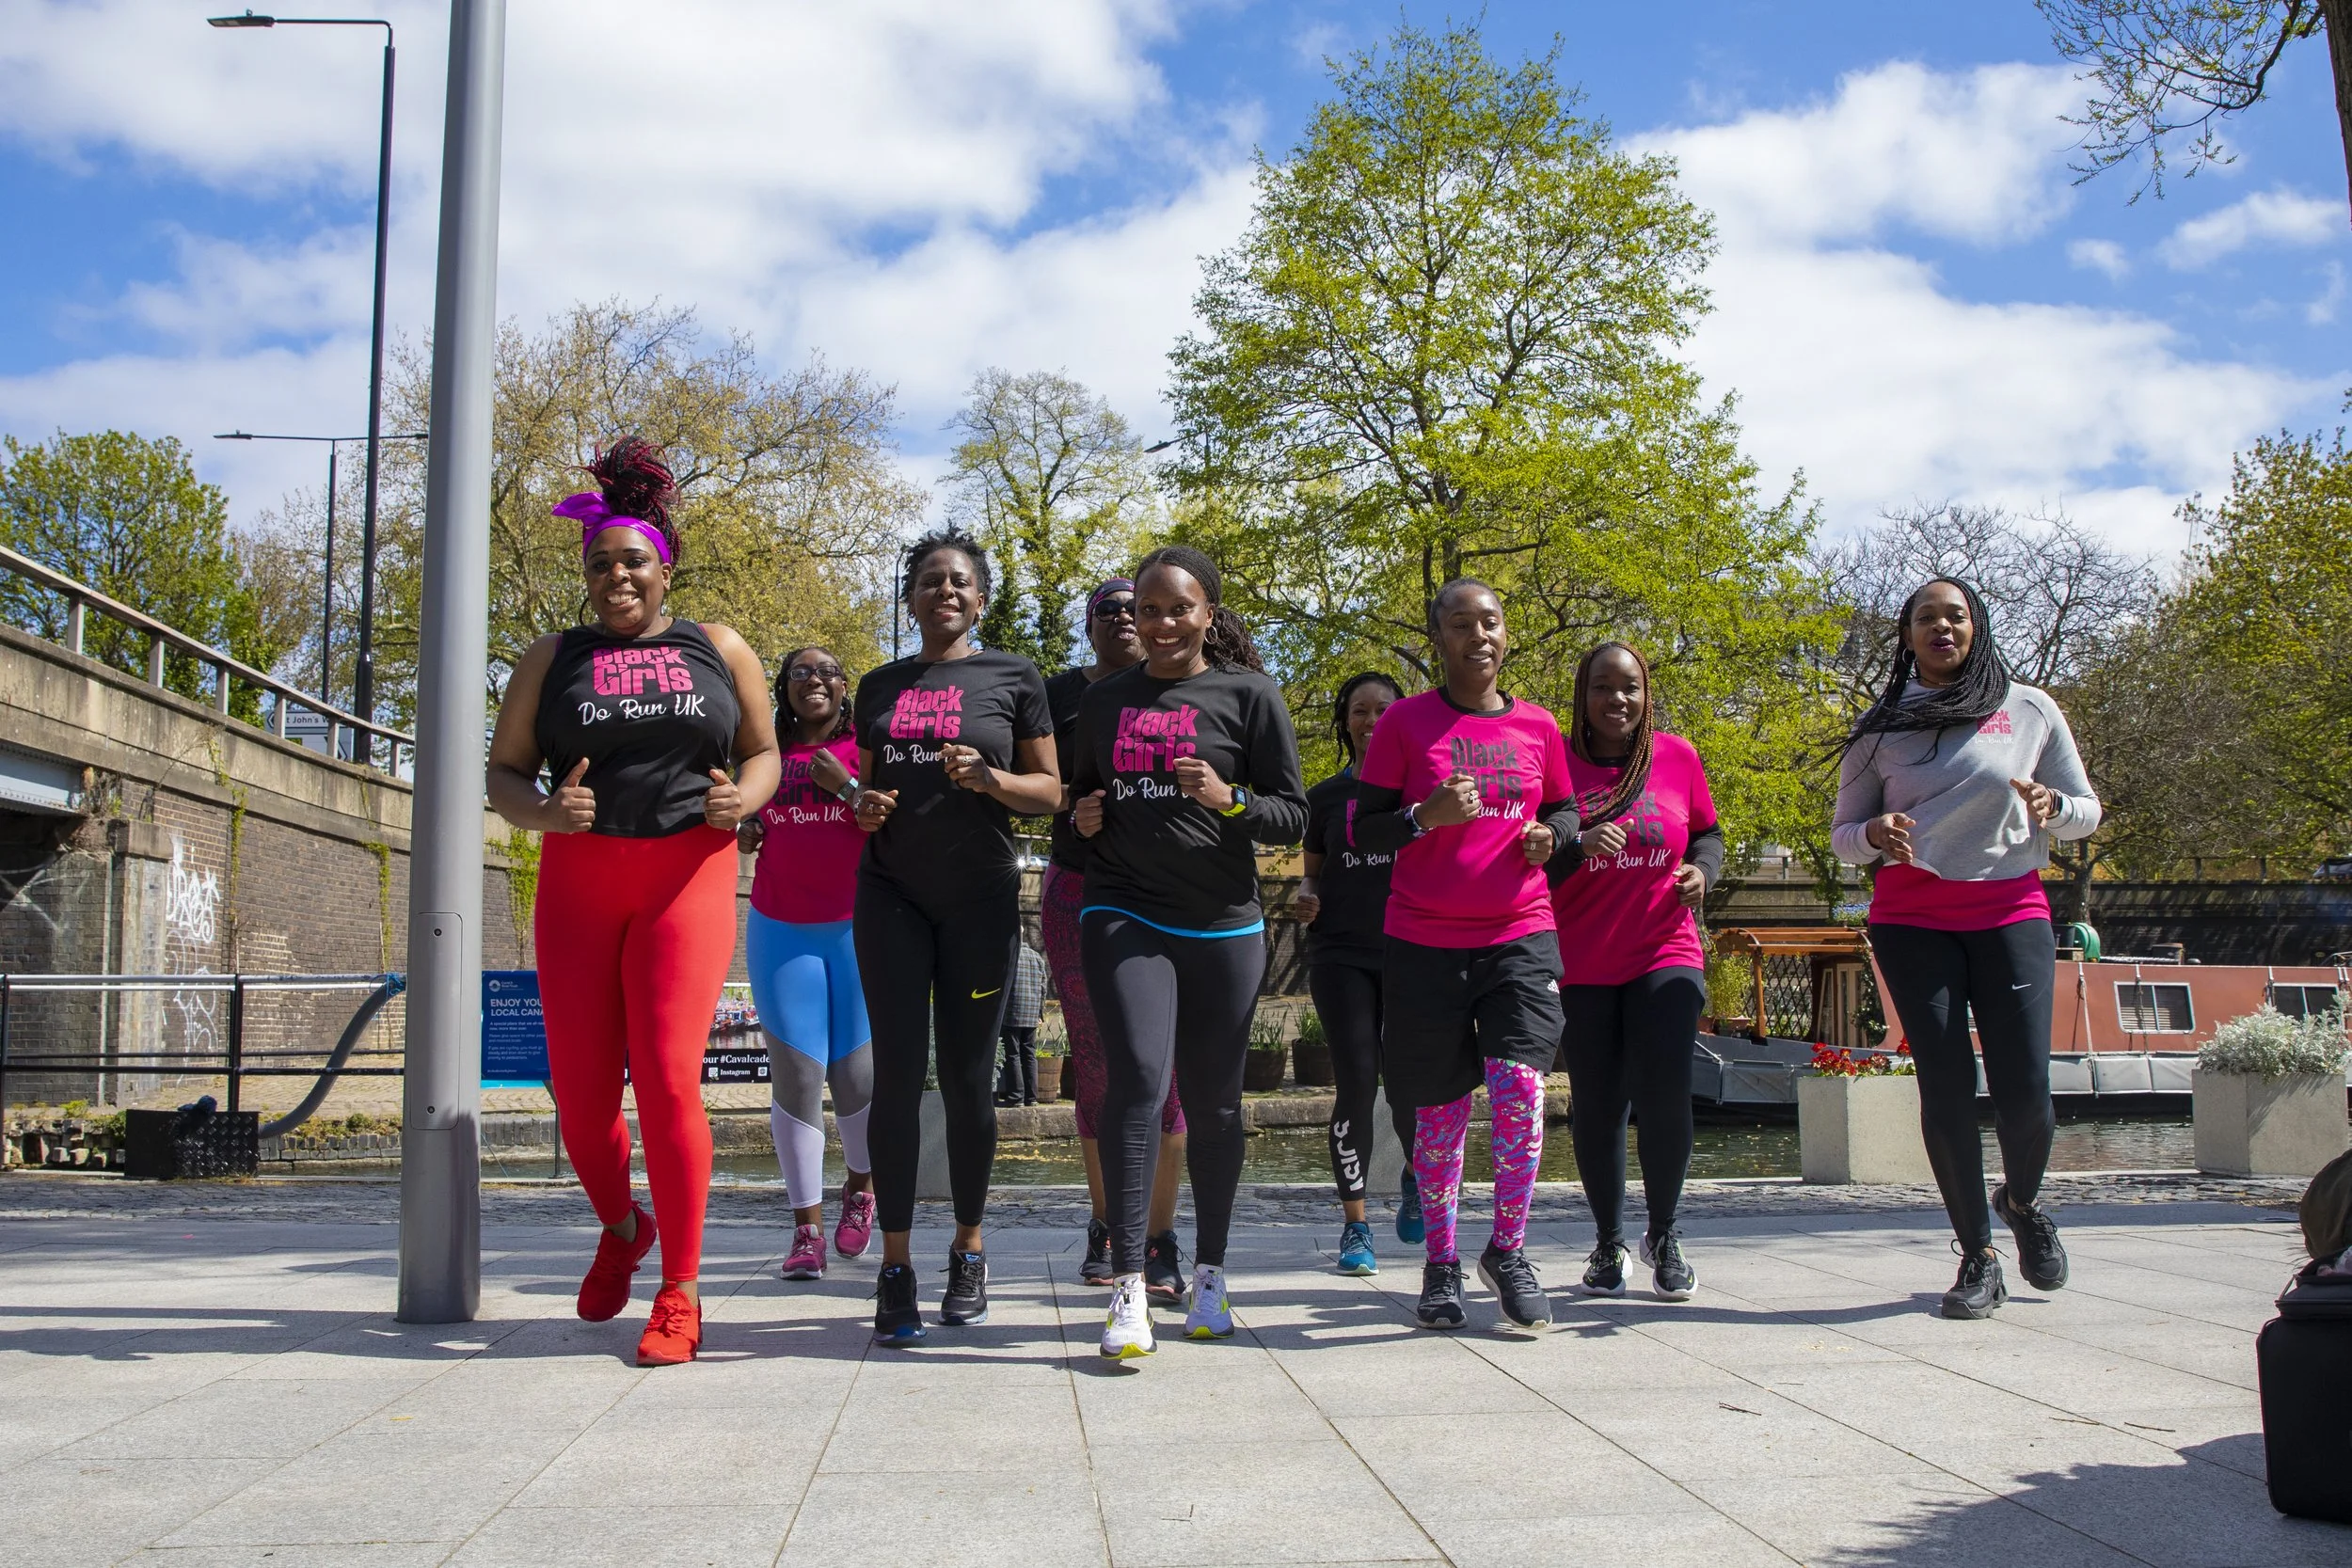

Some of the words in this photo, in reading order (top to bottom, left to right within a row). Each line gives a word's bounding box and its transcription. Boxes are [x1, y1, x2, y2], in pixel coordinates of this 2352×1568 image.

[593, 646, 688, 666] Black
[594, 663, 693, 696] Girls
[578, 702, 612, 725] Do
[619, 699, 666, 720] Run
[674, 694, 706, 717] UK
[895, 685, 964, 713] Black
[889, 712, 961, 739] Girls
[1117, 705, 1200, 737] Black
[883, 744, 906, 764] Do
[909, 744, 940, 764] Run
[1451, 736, 1520, 769] Black
[1113, 778, 1136, 800] Do
[1137, 777, 1178, 800] Run
[1453, 768, 1523, 800] irls
[767, 808, 787, 825] Do
[788, 806, 820, 824] Run
[823, 805, 847, 822] UK
[1503, 800, 1526, 820] UK
[1343, 851, 1361, 868] Do
[1363, 853, 1391, 866] Run
[1589, 855, 1610, 872] Do
[1613, 849, 1645, 869] Run
[1648, 847, 1672, 867] UK
[490, 998, 521, 1007] ENJOY
[523, 998, 542, 1007] YOU
[490, 1008, 520, 1017] LOCAL
[520, 1008, 544, 1017] CANA
